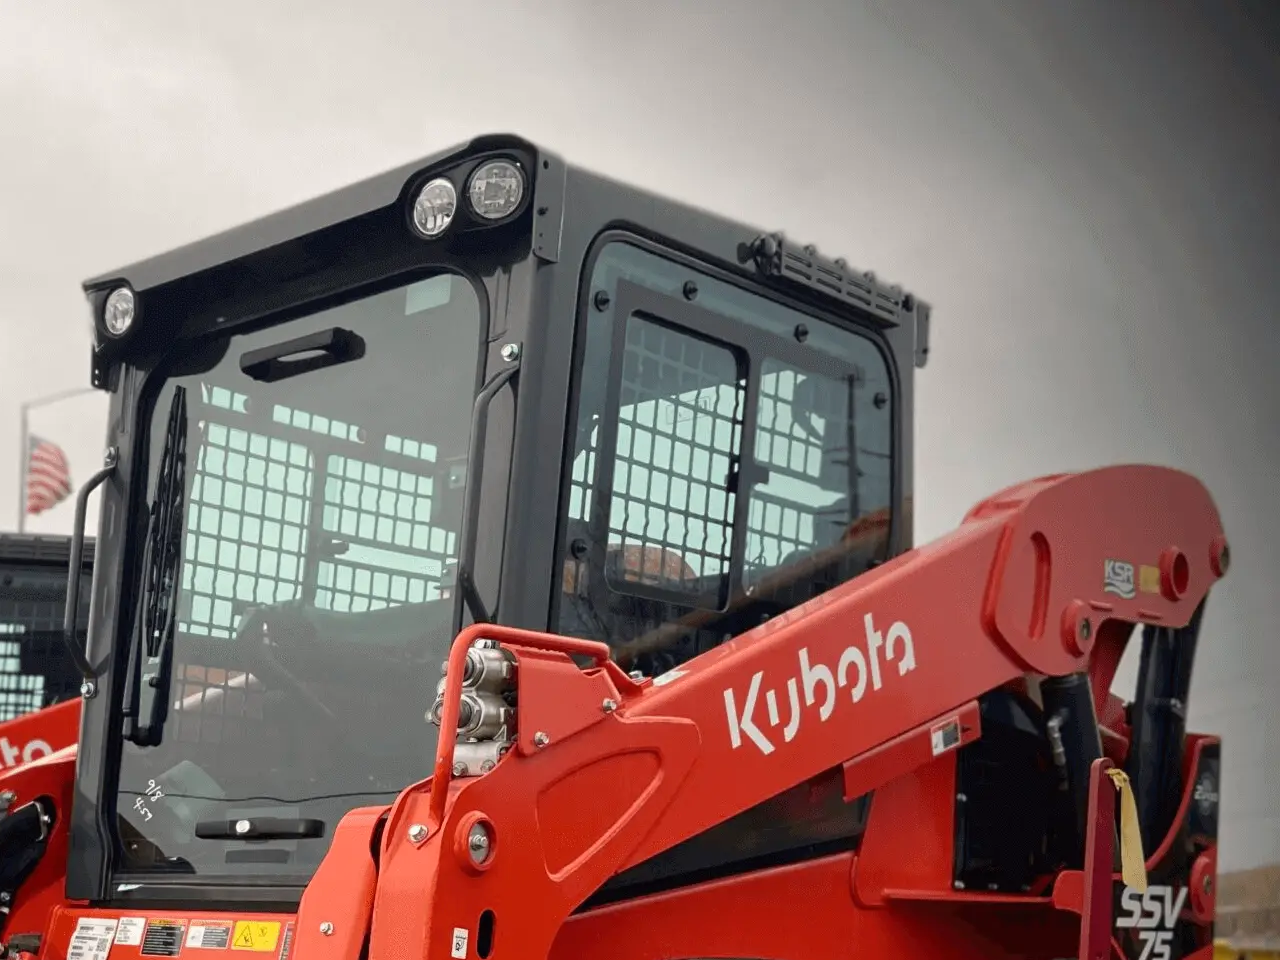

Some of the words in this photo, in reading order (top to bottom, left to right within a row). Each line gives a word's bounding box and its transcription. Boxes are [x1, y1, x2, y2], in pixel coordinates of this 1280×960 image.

[724, 613, 917, 755] Kubota
[145, 779, 165, 801] 9/8
[1116, 885, 1188, 928] SSV
